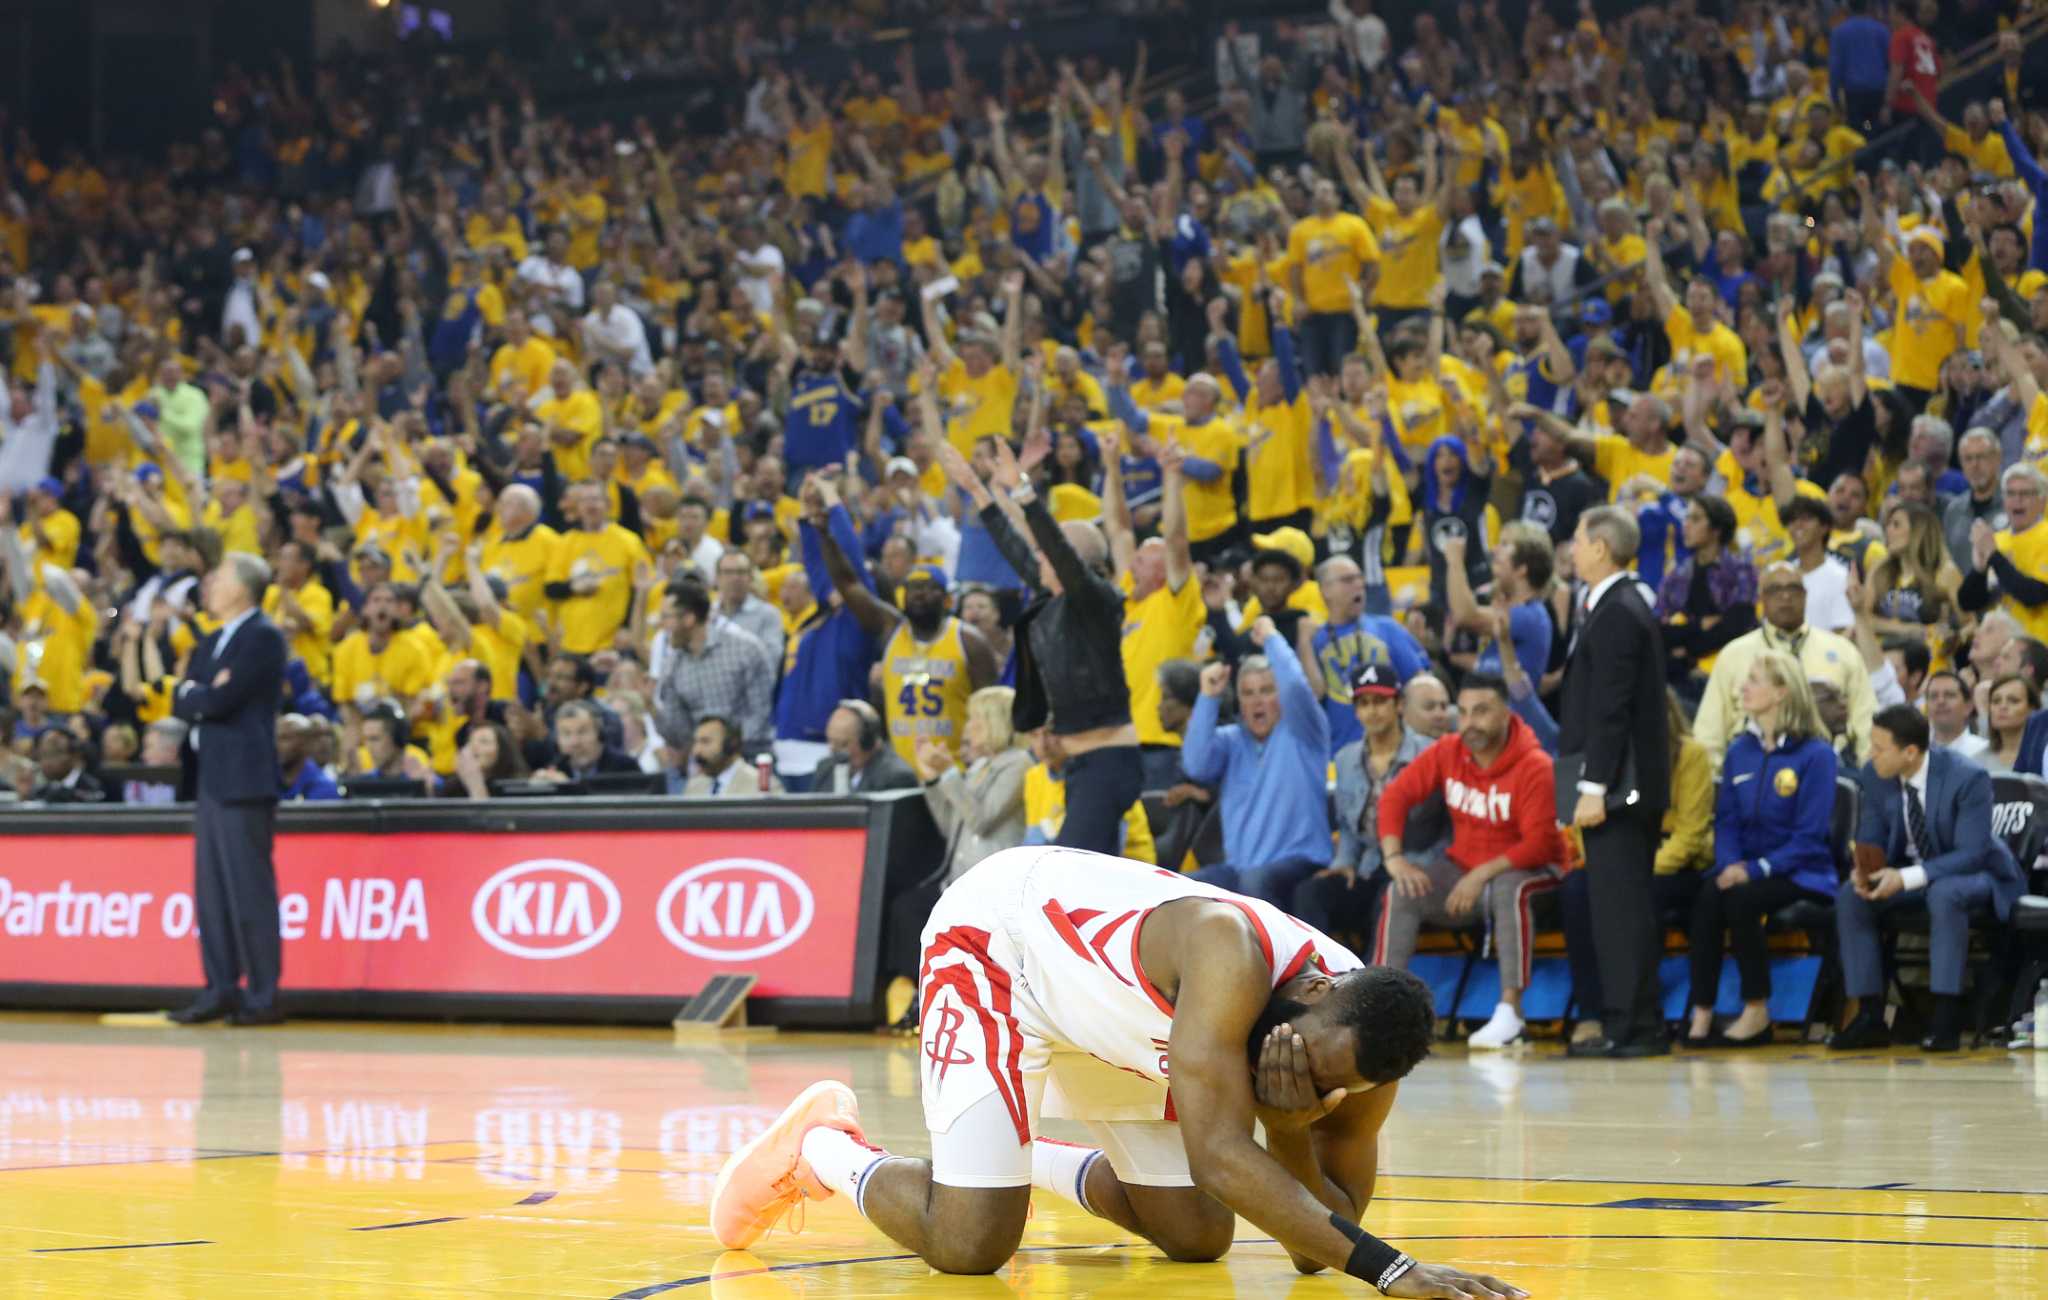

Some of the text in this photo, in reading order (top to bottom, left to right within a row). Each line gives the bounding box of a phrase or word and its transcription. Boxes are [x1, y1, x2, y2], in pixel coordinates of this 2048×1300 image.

[898, 679, 943, 717] 45
[161, 892, 200, 939] o
[319, 877, 429, 941] NBA
[496, 880, 595, 937] KIA
[682, 880, 787, 938] KIA
